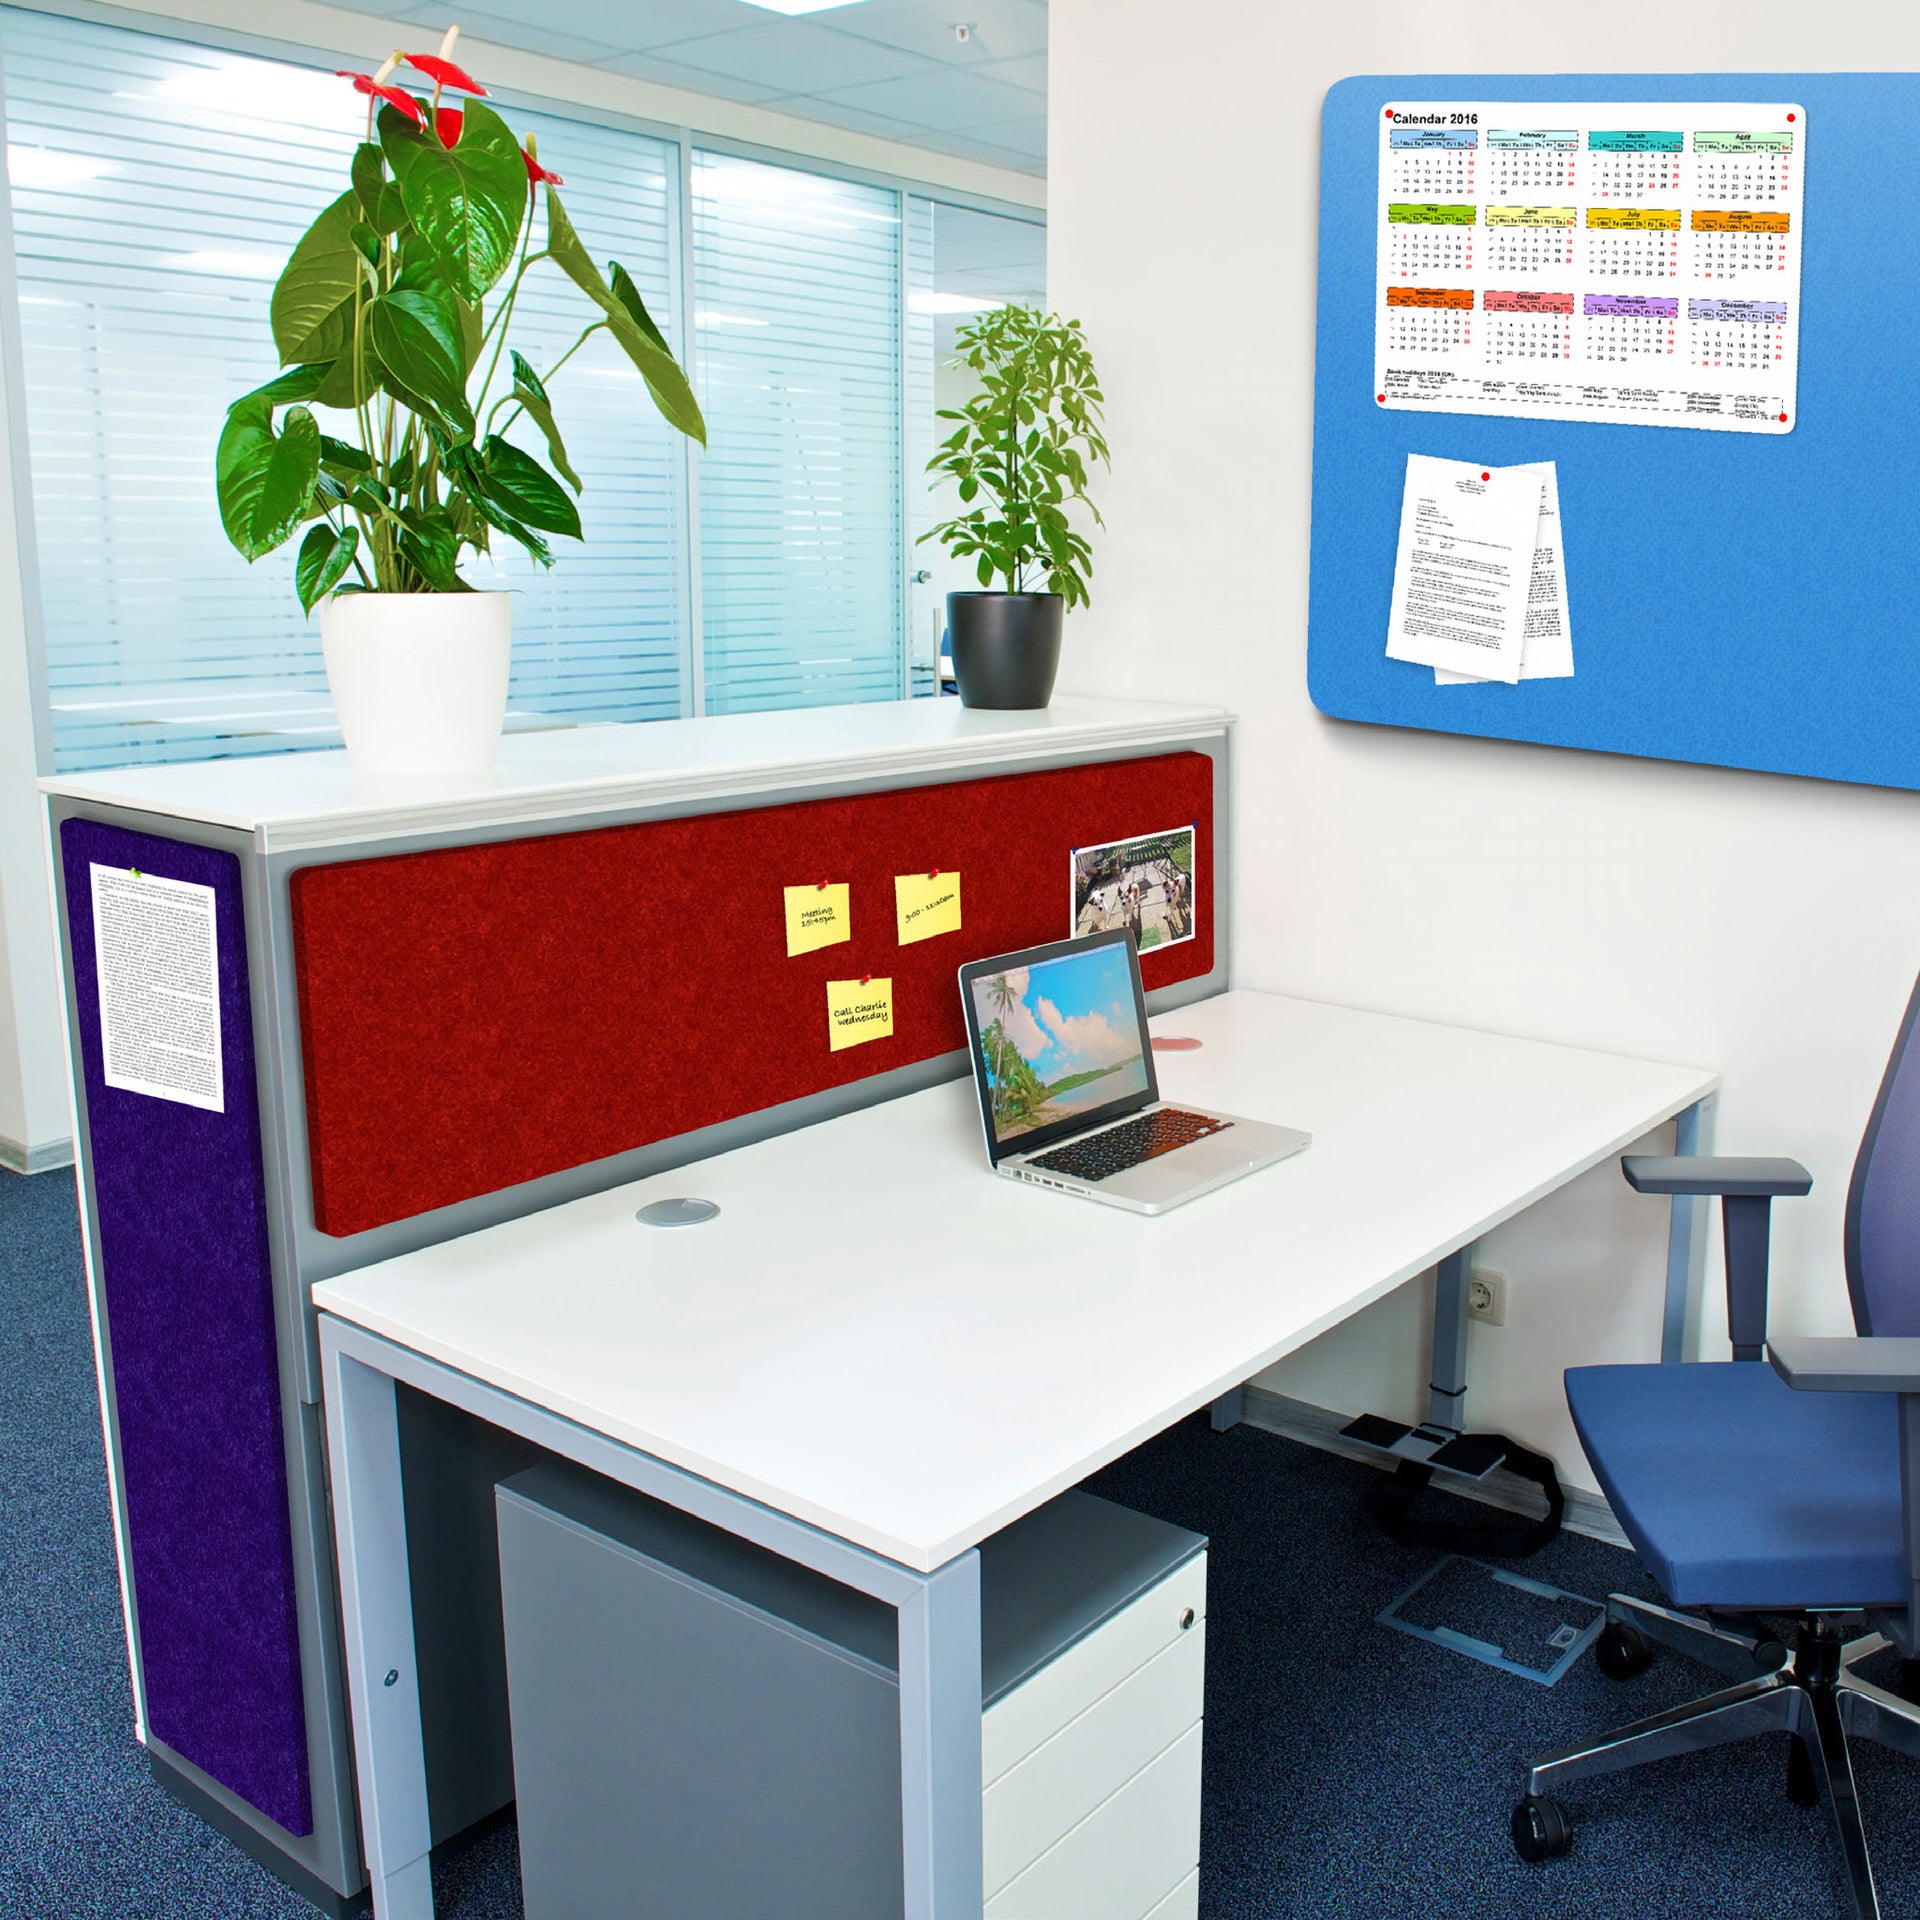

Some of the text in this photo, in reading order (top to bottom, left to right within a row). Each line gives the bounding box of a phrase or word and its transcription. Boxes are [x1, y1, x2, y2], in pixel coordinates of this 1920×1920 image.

[1393, 113, 1478, 124] Calendar 2016
[801, 906, 833, 918] Meeting
[855, 1000, 887, 1013] Charlie
